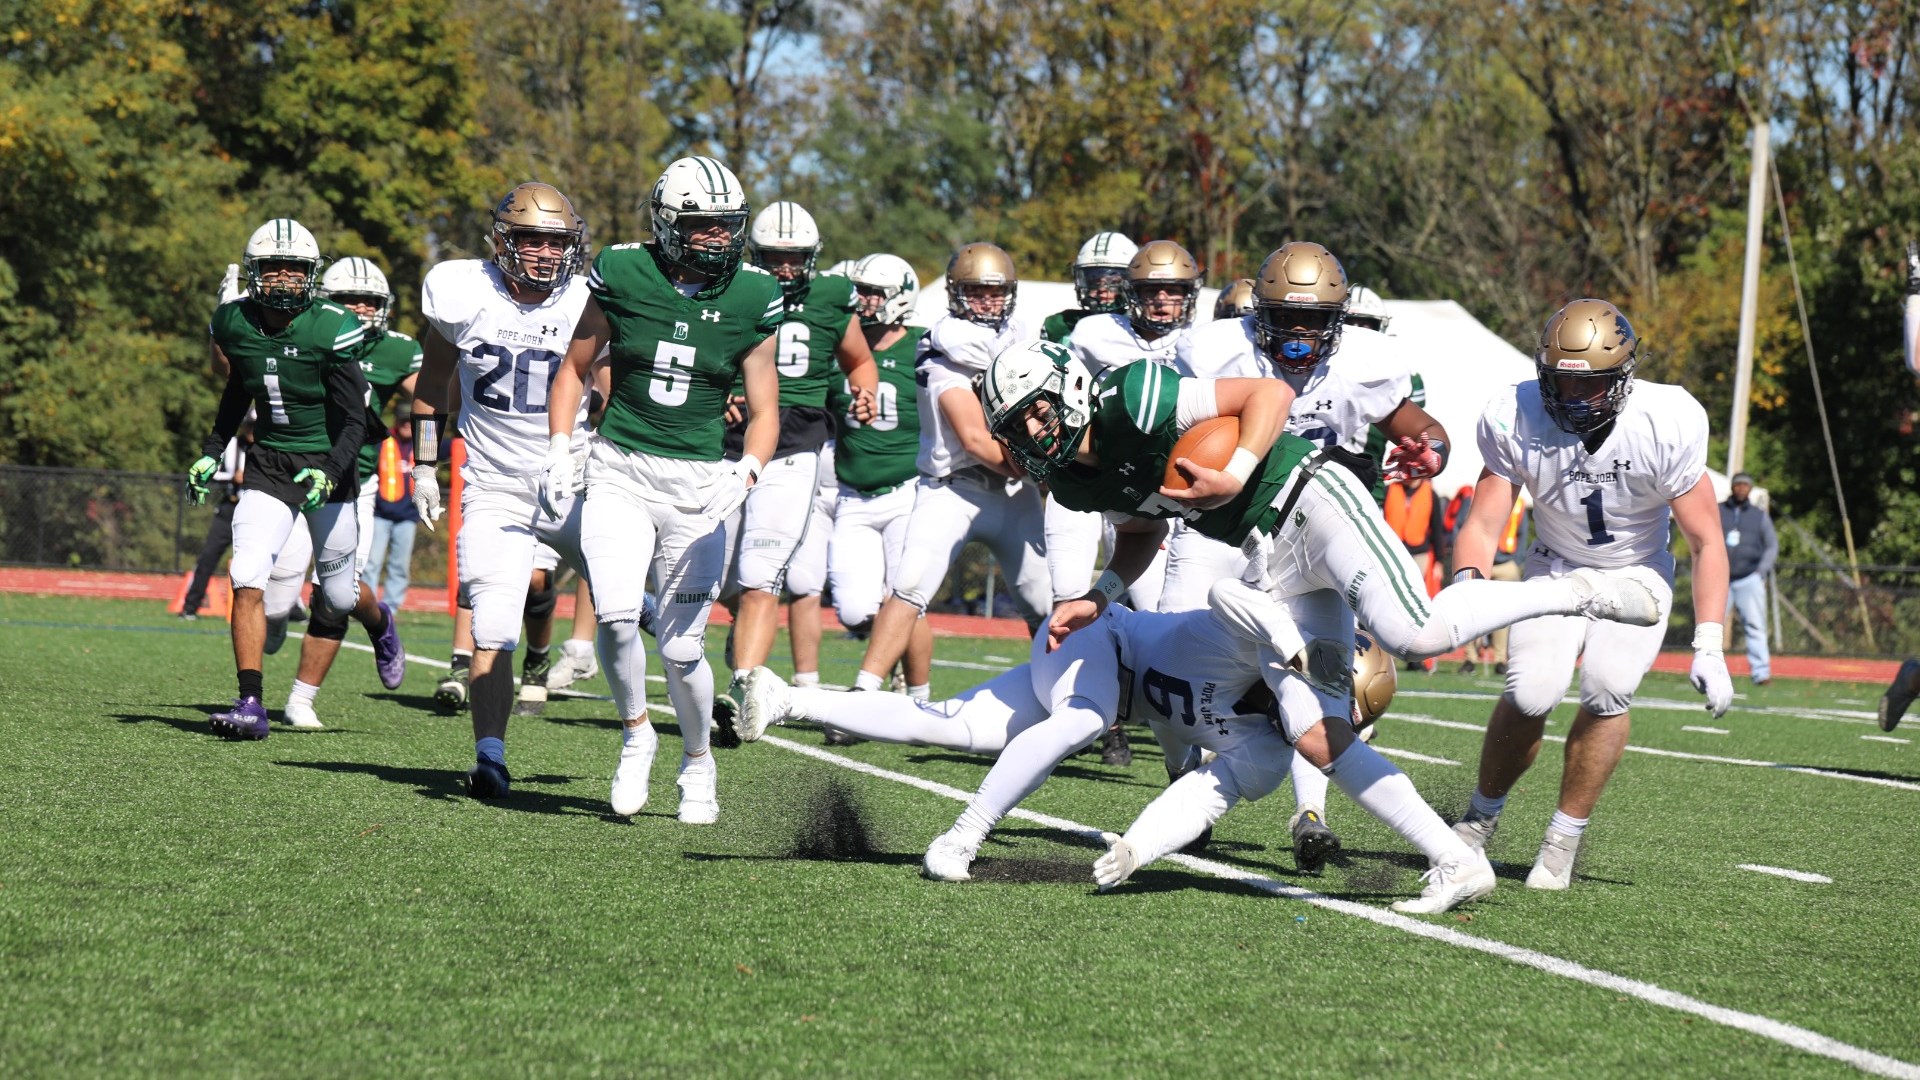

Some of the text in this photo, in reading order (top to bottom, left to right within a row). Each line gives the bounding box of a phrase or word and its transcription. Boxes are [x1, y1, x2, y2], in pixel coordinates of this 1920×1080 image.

[497, 329, 544, 346] POPE JOHN
[472, 343, 562, 414] 20
[648, 340, 697, 407] 5
[1560, 361, 1586, 369] Riddell
[263, 374, 290, 425] 1
[1569, 470, 1618, 484] POPE JOHN
[1580, 489, 1616, 545] 1
[1143, 666, 1197, 727] 6
[1201, 681, 1217, 705] POPE
